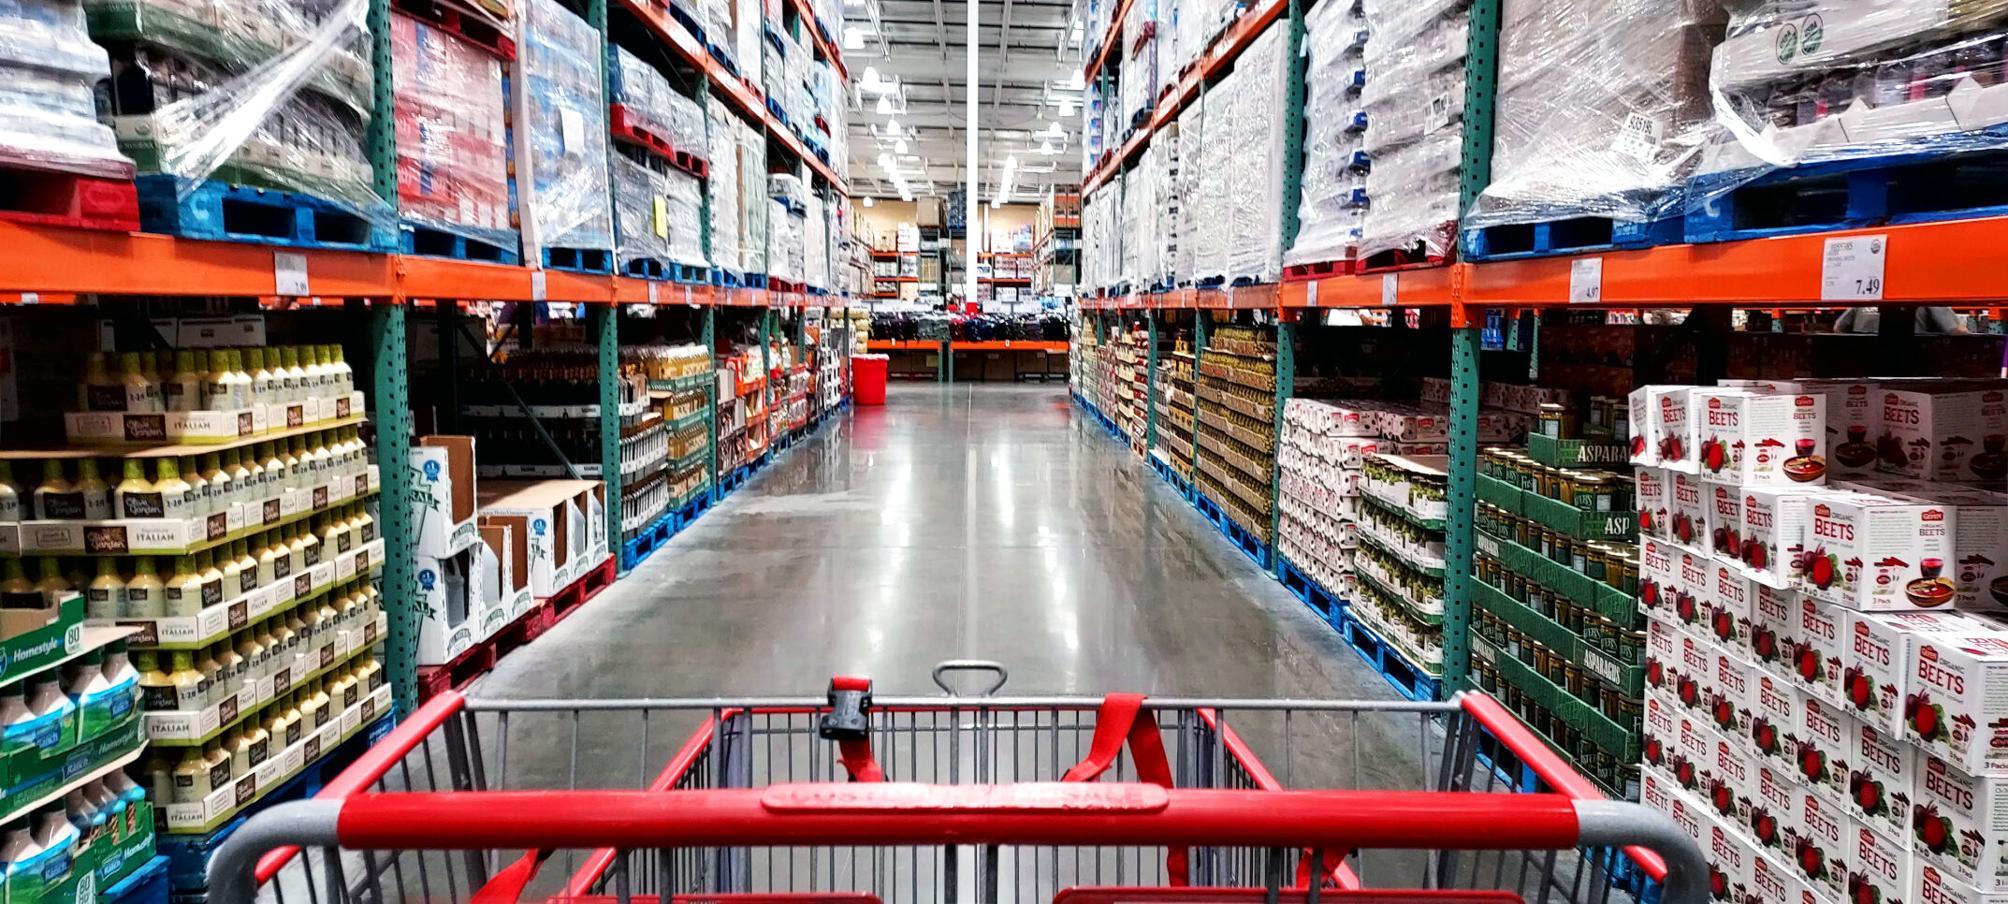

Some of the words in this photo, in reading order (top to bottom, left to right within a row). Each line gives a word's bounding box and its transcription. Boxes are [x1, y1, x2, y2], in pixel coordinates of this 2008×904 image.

[1856, 279, 1880, 295] 7.49
[174, 422, 211, 430] ITALIAN
[1663, 408, 1686, 423] BEETS
[1709, 412, 1739, 426] BEETS
[1883, 406, 1919, 424] BEETS
[1577, 445, 1629, 463] ASPARA
[1640, 483, 1662, 496] BEETS
[1676, 486, 1699, 504] BEETS
[1716, 500, 1740, 517] BEET
[1747, 508, 1773, 528] BEETS
[136, 533, 175, 542] ITALIAN
[1815, 518, 1854, 541] BEETS
[1920, 529, 1945, 537] BEETS
[1645, 551, 1671, 572] BEETS
[1682, 563, 1707, 586] BEETS
[1718, 579, 1744, 603] BEETS
[1759, 596, 1788, 621] BEETS
[68, 627, 80, 645] 80
[161, 628, 195, 636] ITALIAN
[1803, 613, 1835, 640] BEETS
[13, 636, 59, 663] Homestyle
[1651, 632, 1673, 653] BEETS
[1855, 635, 1890, 666] BEETS
[1584, 648, 1621, 686] ASPARAGUS
[1684, 649, 1708, 672] BEETS
[1719, 668, 1745, 693] BEETS
[1919, 658, 1964, 695] BEETS
[1761, 689, 1790, 717] BEETS
[151, 724, 190, 733] ITALIAN
[1649, 709, 1672, 733] BEETS
[1807, 711, 1840, 743] BEETS
[1681, 730, 1707, 756] BEETS
[67, 758, 89, 775] Ranch
[1718, 753, 1745, 781] BEETS
[1862, 738, 1900, 774] BEETS
[1761, 779, 1790, 810] BEETS
[1926, 770, 1974, 810] BEETS
[170, 813, 203, 822] ITALIAN
[1805, 808, 1839, 842] BEETS
[1712, 836, 1741, 868] BEETS
[1859, 841, 1897, 880] BEETS
[79, 876, 91, 894] 80
[1755, 871, 1786, 903] BEETS
[1923, 879, 1956, 904] BEE
